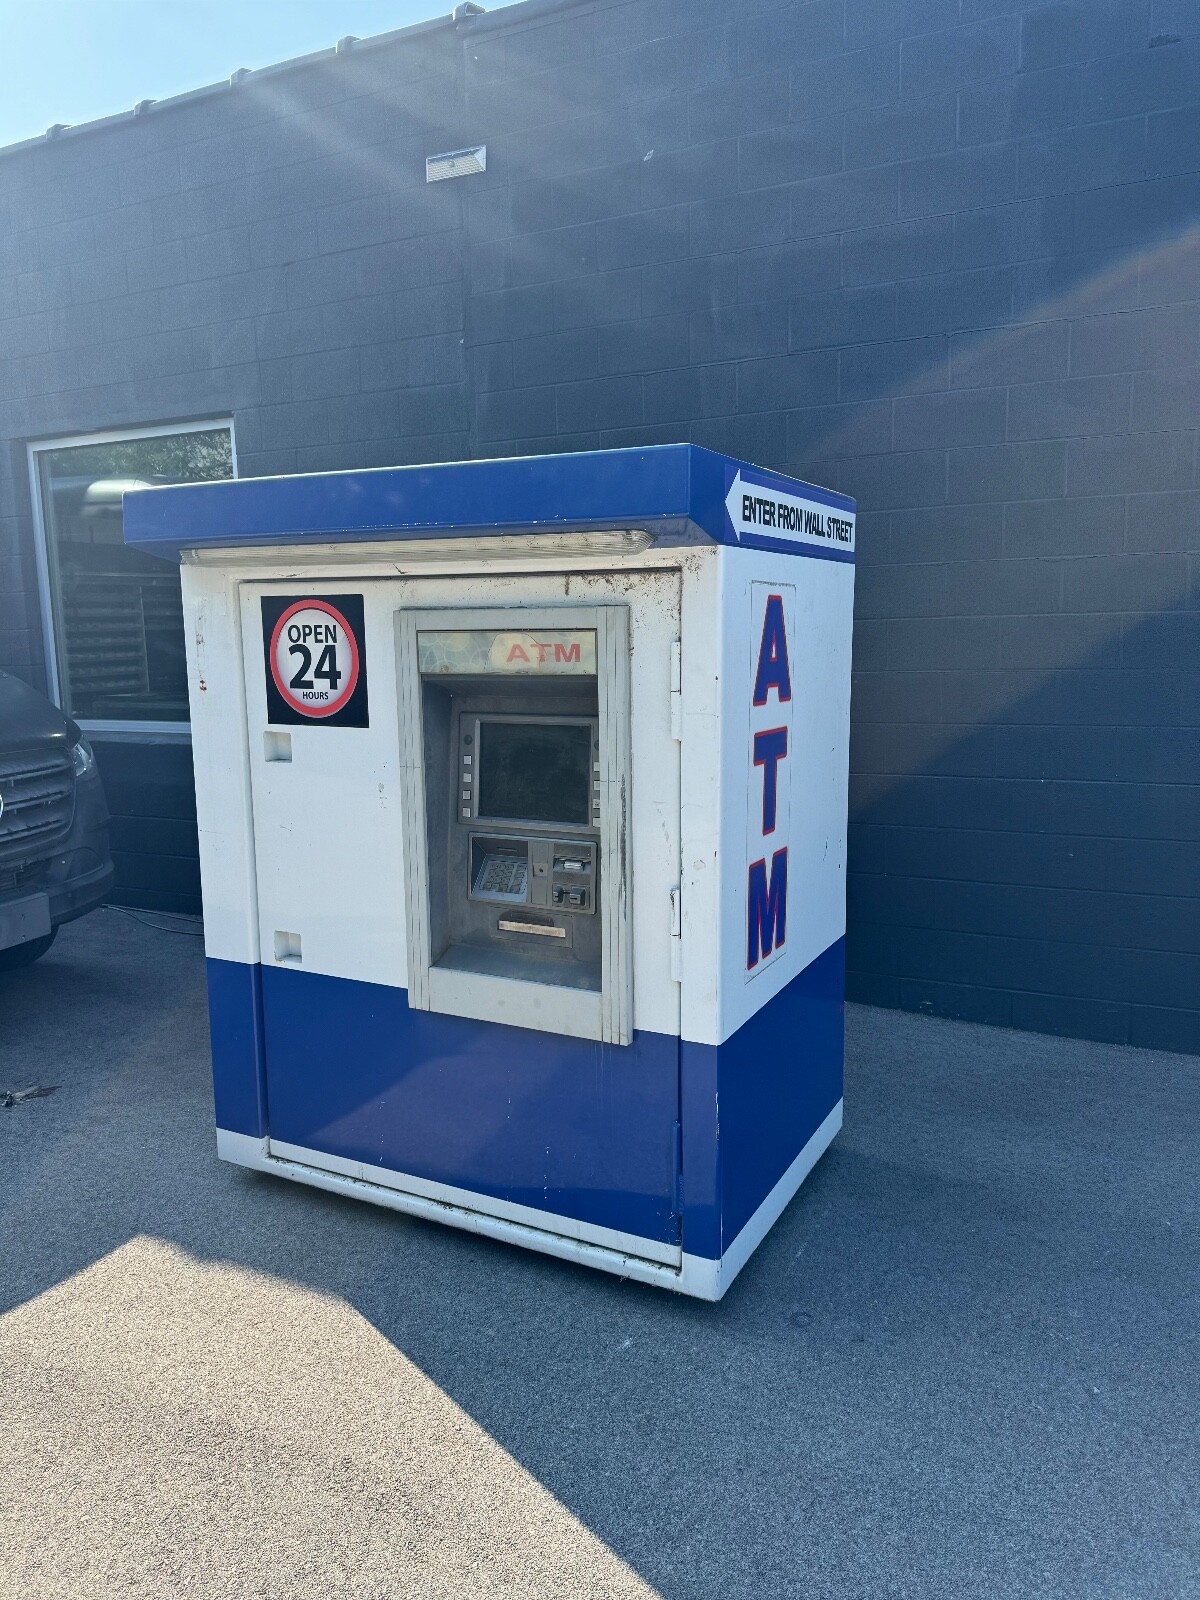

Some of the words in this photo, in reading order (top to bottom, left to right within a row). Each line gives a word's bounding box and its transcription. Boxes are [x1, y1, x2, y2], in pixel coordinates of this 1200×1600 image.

[742, 494, 777, 527] ENTER
[777, 503, 803, 532] FROM
[804, 510, 825, 538] WALL
[826, 516, 853, 543] STREET
[287, 624, 338, 644] OPEN
[288, 643, 342, 690] 24
[506, 643, 581, 663] ATM
[302, 691, 329, 700] HOURS
[747, 594, 792, 970] ATM
